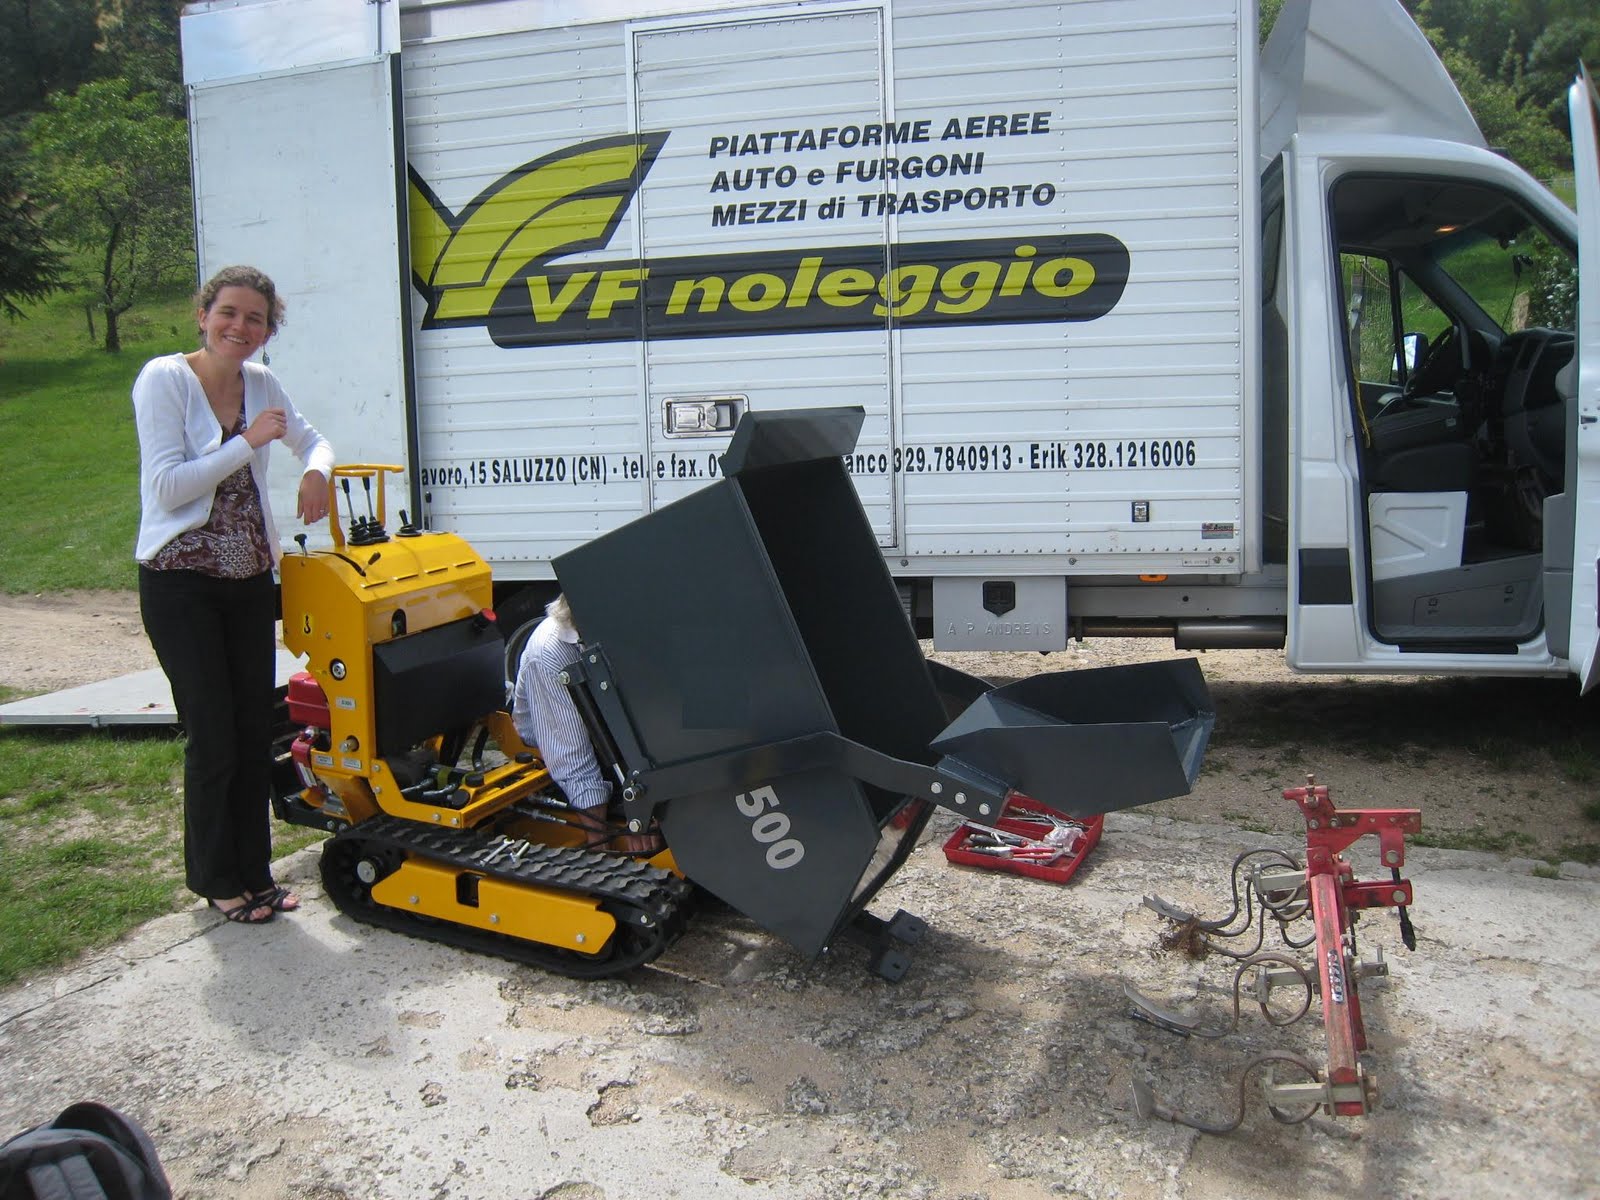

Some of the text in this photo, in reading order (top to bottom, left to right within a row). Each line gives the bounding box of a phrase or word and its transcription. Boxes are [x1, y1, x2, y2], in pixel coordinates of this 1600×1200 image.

[709, 112, 1052, 158] PIATTAFORME AEREE
[710, 152, 985, 193] AUTO e FURGONI
[711, 183, 1056, 227] MEZZI di TRASPORTO
[524, 245, 1096, 323] VF noleggio
[421, 460, 487, 489] avoro,15
[492, 457, 566, 484] SALUZZO
[572, 455, 607, 486] (CN)
[656, 459, 666, 479] e
[671, 452, 703, 478] fax.
[845, 454, 888, 474] anco
[893, 446, 1012, 474] 329.7840913
[1030, 444, 1067, 470] Erik
[1074, 440, 1196, 469] 328.1216006
[735, 785, 805, 870] 500
